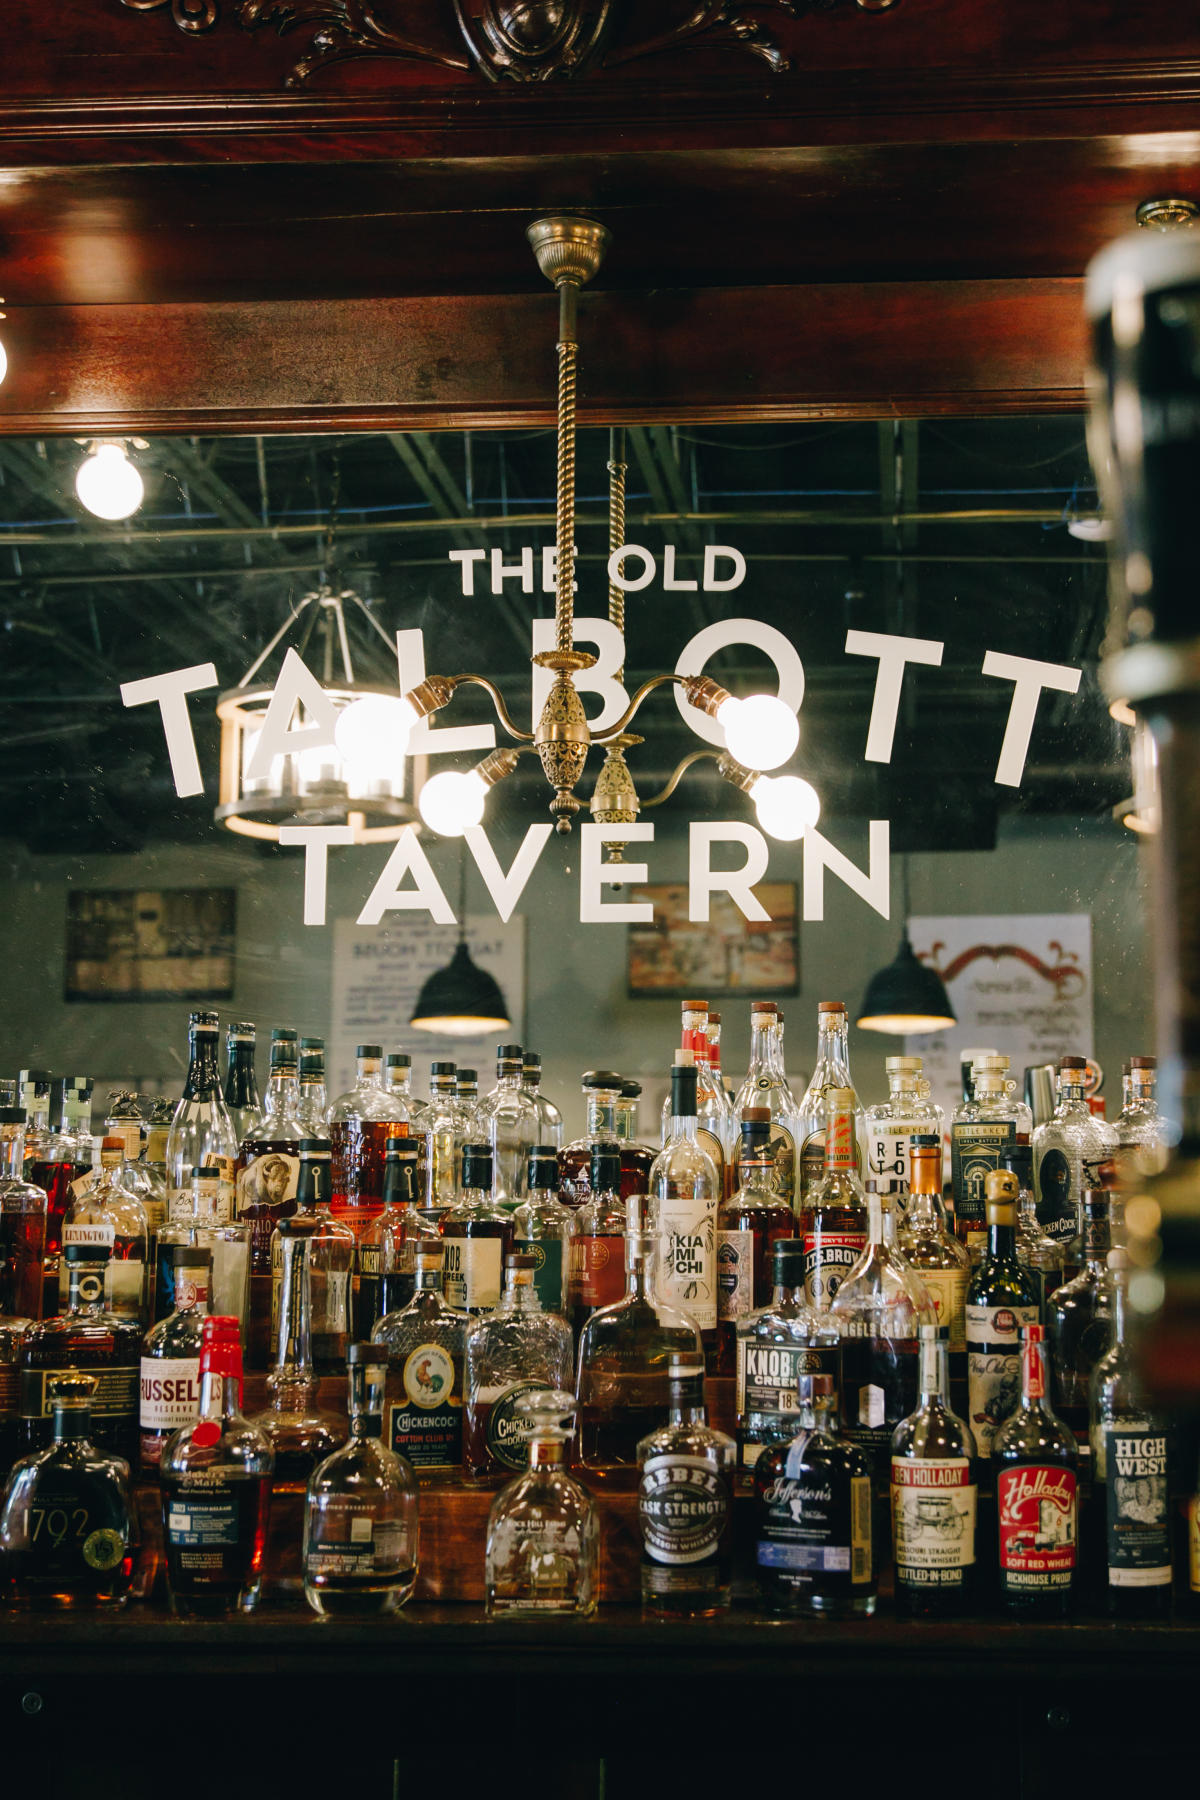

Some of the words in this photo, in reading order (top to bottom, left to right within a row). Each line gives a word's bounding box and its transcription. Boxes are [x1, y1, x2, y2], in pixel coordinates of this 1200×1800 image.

[608, 544, 746, 592] OLD
[119, 616, 1082, 799] TALBOTT
[278, 819, 890, 927] TAVERN
[676, 1235, 704, 1248] KIA
[444, 1245, 461, 1271] NOB
[676, 1248, 696, 1260] MI
[675, 1261, 703, 1273] CHI
[747, 1349, 791, 1377] KNOB
[754, 1375, 798, 1387] CREEK
[782, 1394, 792, 1409] 18
[1115, 1438, 1166, 1457] HIGH
[912, 1467, 963, 1486] HOLLADAY
[1115, 1457, 1167, 1477] WEST
[643, 1466, 718, 1493] REBEL
[763, 1476, 832, 1506] Jefferson's
[1004, 1469, 1073, 1512] Holladay
[24, 1509, 89, 1547] 1792
[1027, 1559, 1045, 1569] RED
